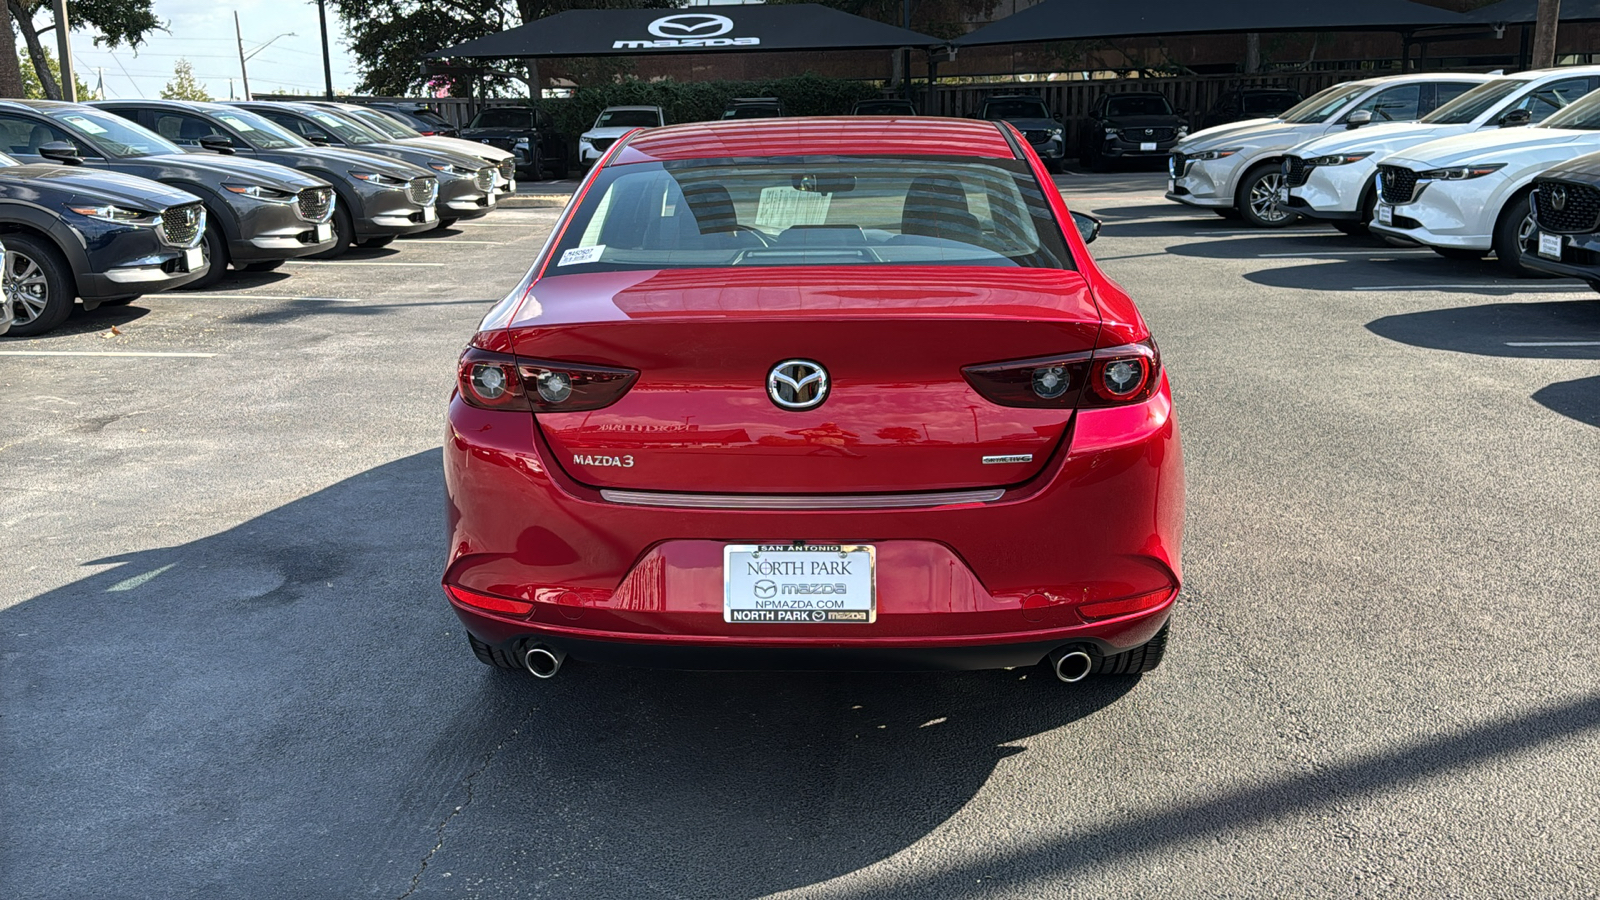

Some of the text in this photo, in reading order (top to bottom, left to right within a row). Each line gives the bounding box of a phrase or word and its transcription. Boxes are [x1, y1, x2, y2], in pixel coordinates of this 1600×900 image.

[612, 37, 760, 49] mazda
[747, 560, 852, 577] NORTH PARK
[781, 583, 847, 595] mazda
[755, 600, 844, 609] NPMAZDA.COM
[733, 611, 867, 621] NORTH PARK mazda
